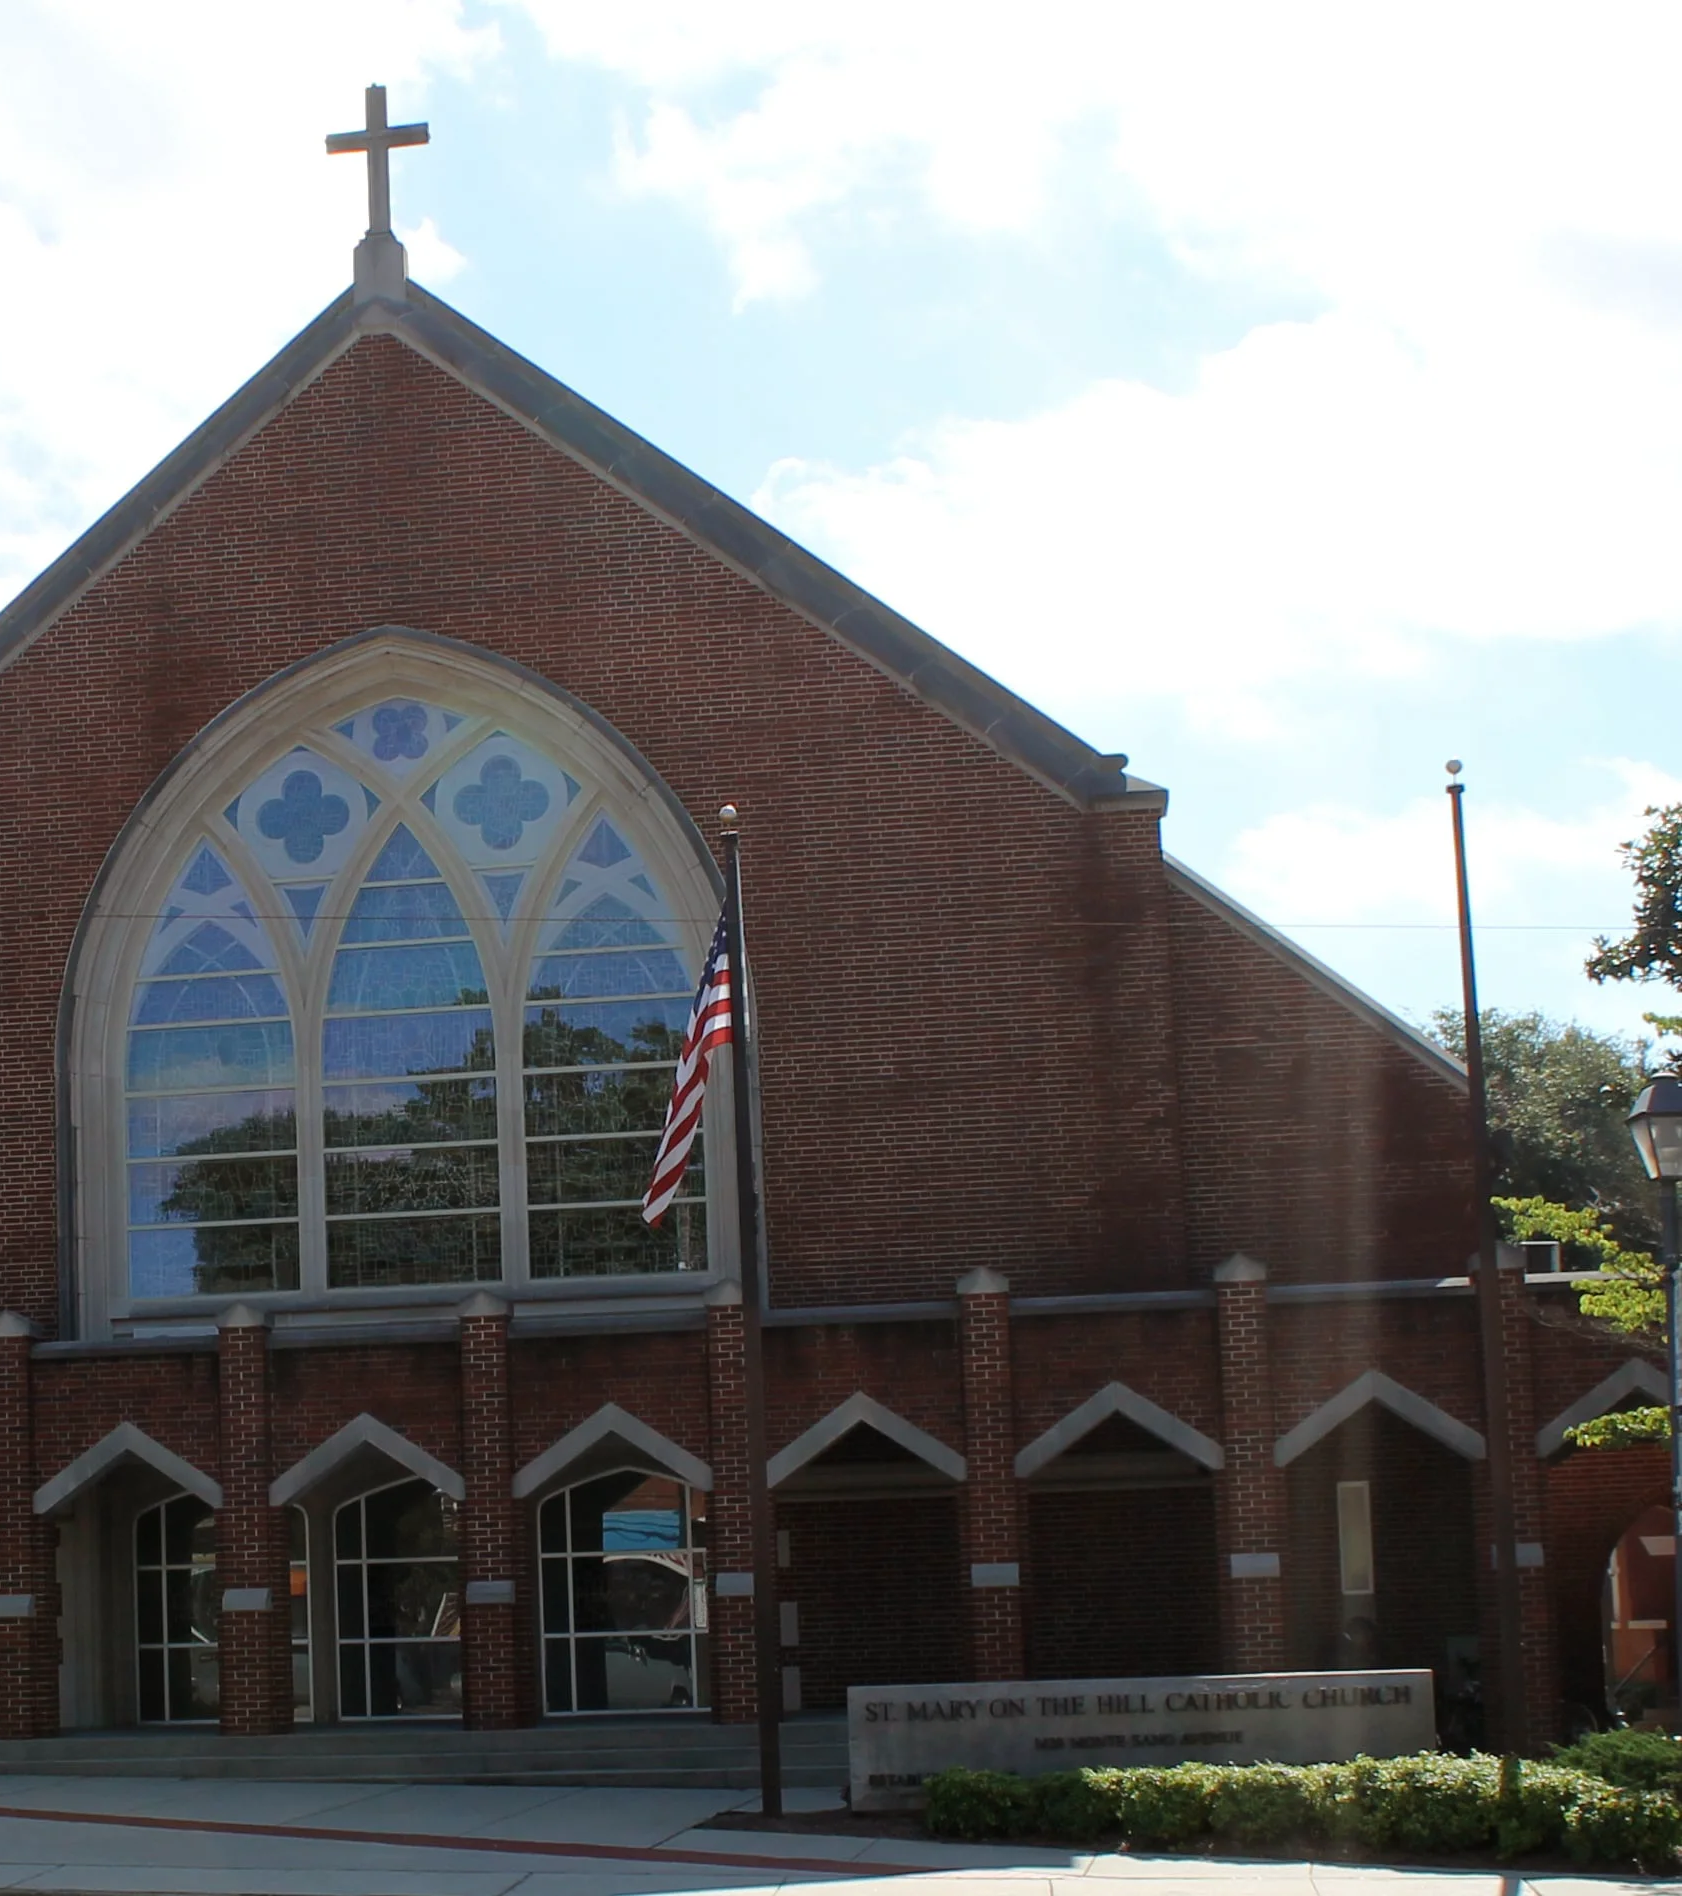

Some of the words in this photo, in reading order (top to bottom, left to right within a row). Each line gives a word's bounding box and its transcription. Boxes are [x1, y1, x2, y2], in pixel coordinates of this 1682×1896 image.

[865, 1701, 898, 1723] ST.
[907, 1699, 981, 1722] MARY
[989, 1697, 1025, 1718] ON
[1037, 1695, 1085, 1717] THE
[1097, 1693, 1155, 1715] HILL
[1165, 1690, 1293, 1712] CATHOLIC
[1302, 1685, 1414, 1709] CHURCH
